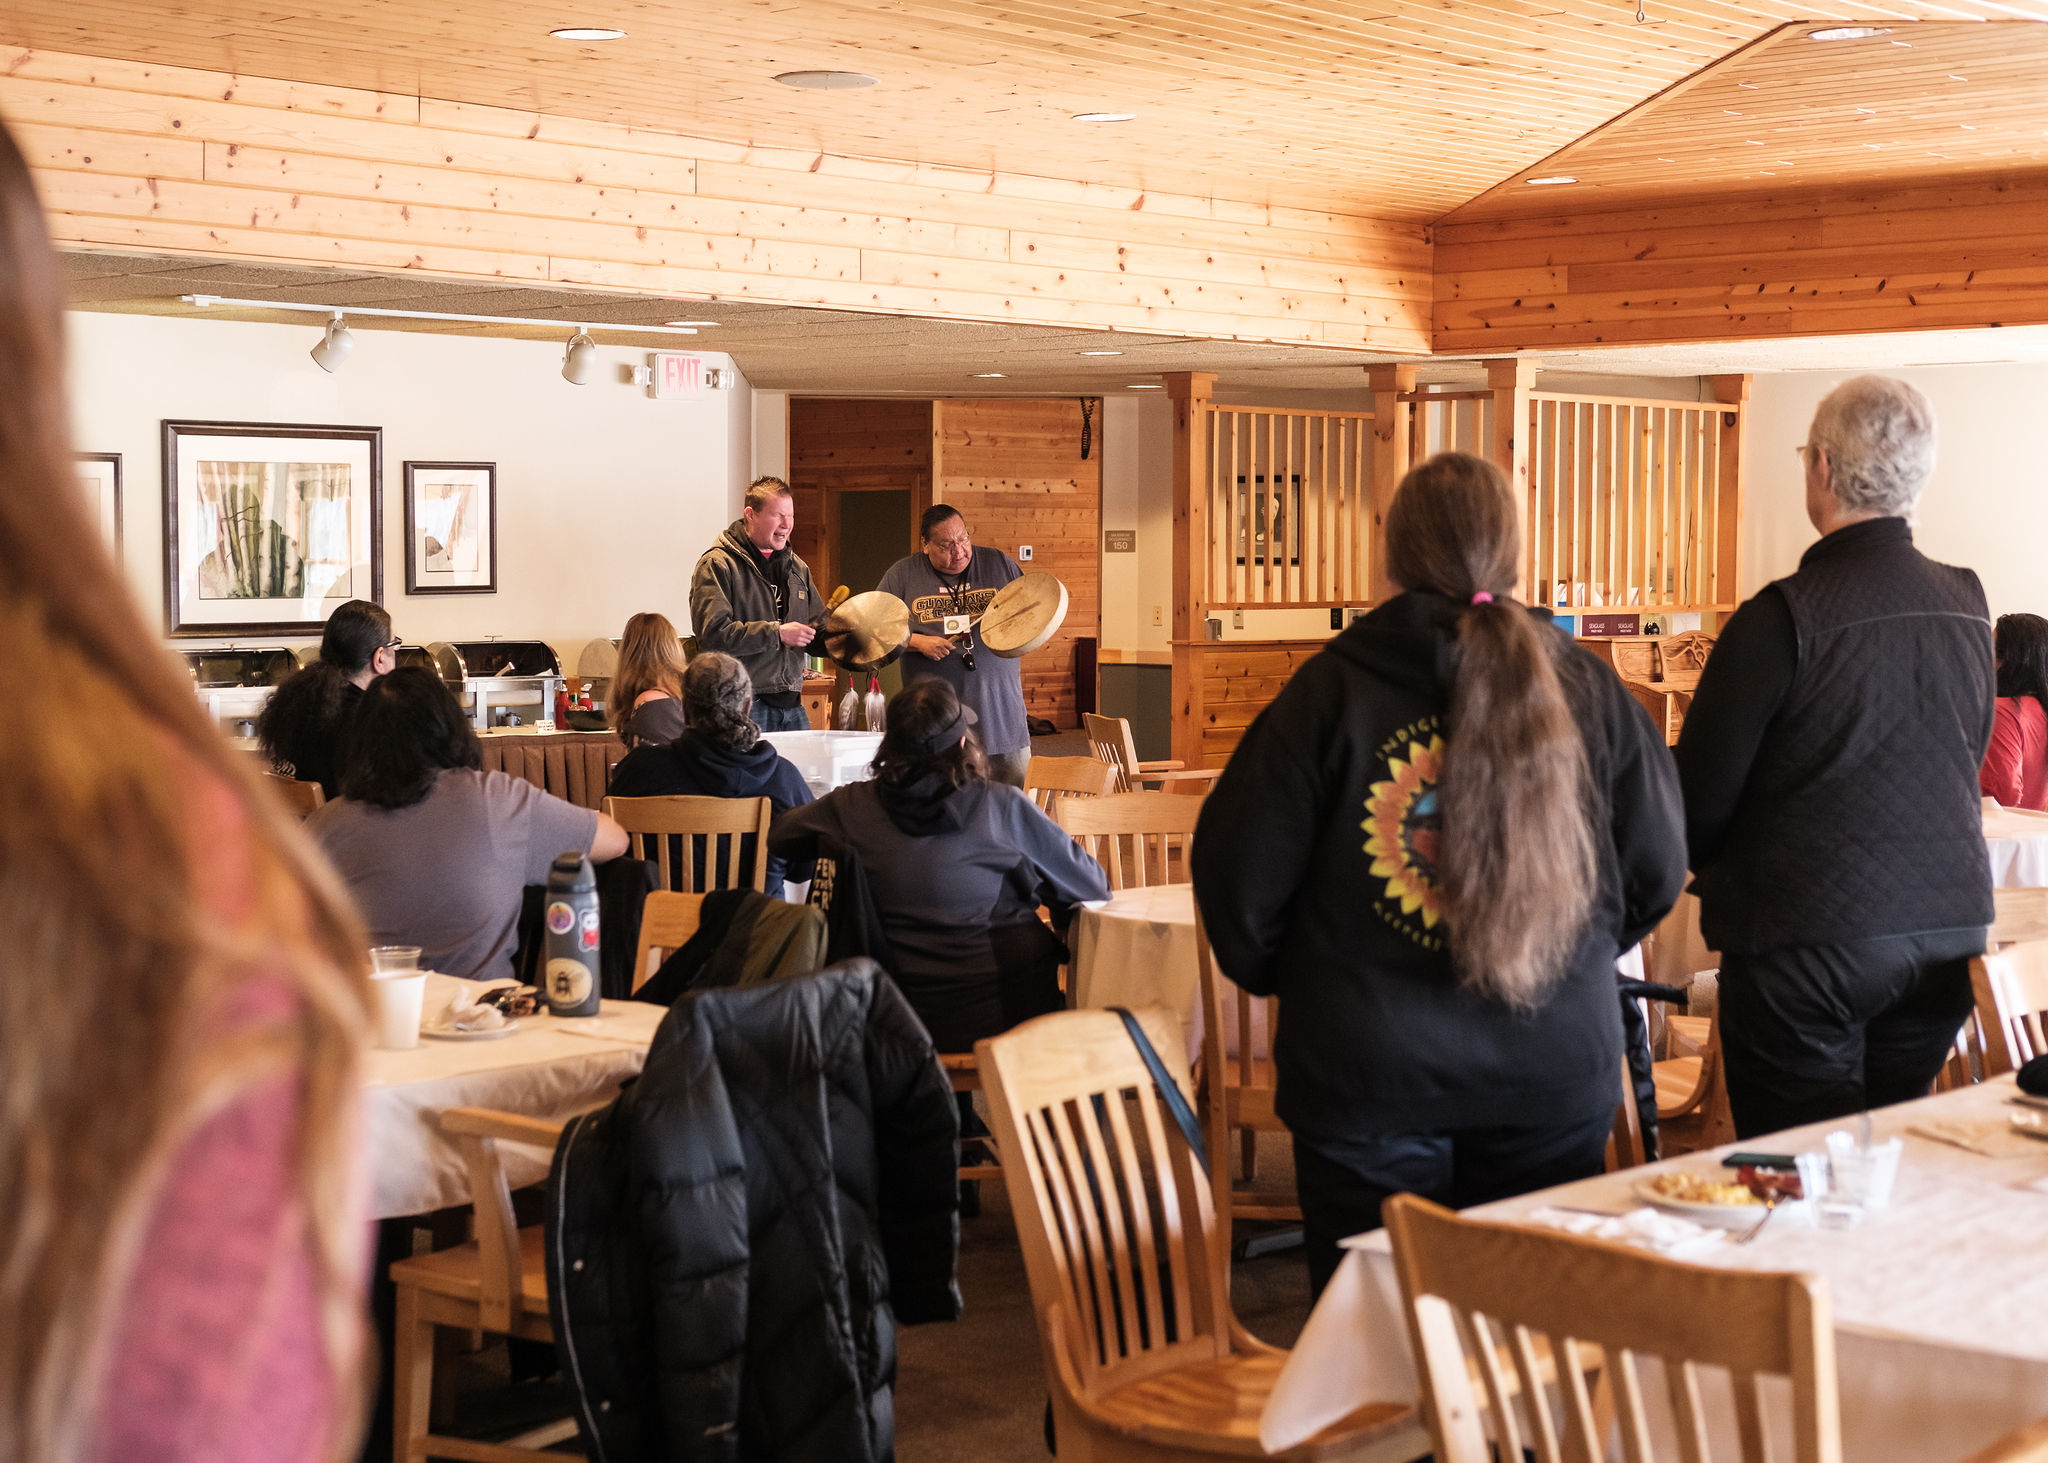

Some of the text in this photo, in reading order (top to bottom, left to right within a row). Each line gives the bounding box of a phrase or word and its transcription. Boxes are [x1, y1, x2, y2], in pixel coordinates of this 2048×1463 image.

[665, 357, 701, 393] EXIT
[1113, 541, 1128, 550] 150
[934, 602, 991, 618] GAAXY
[1375, 714, 1439, 761] INDIGE
